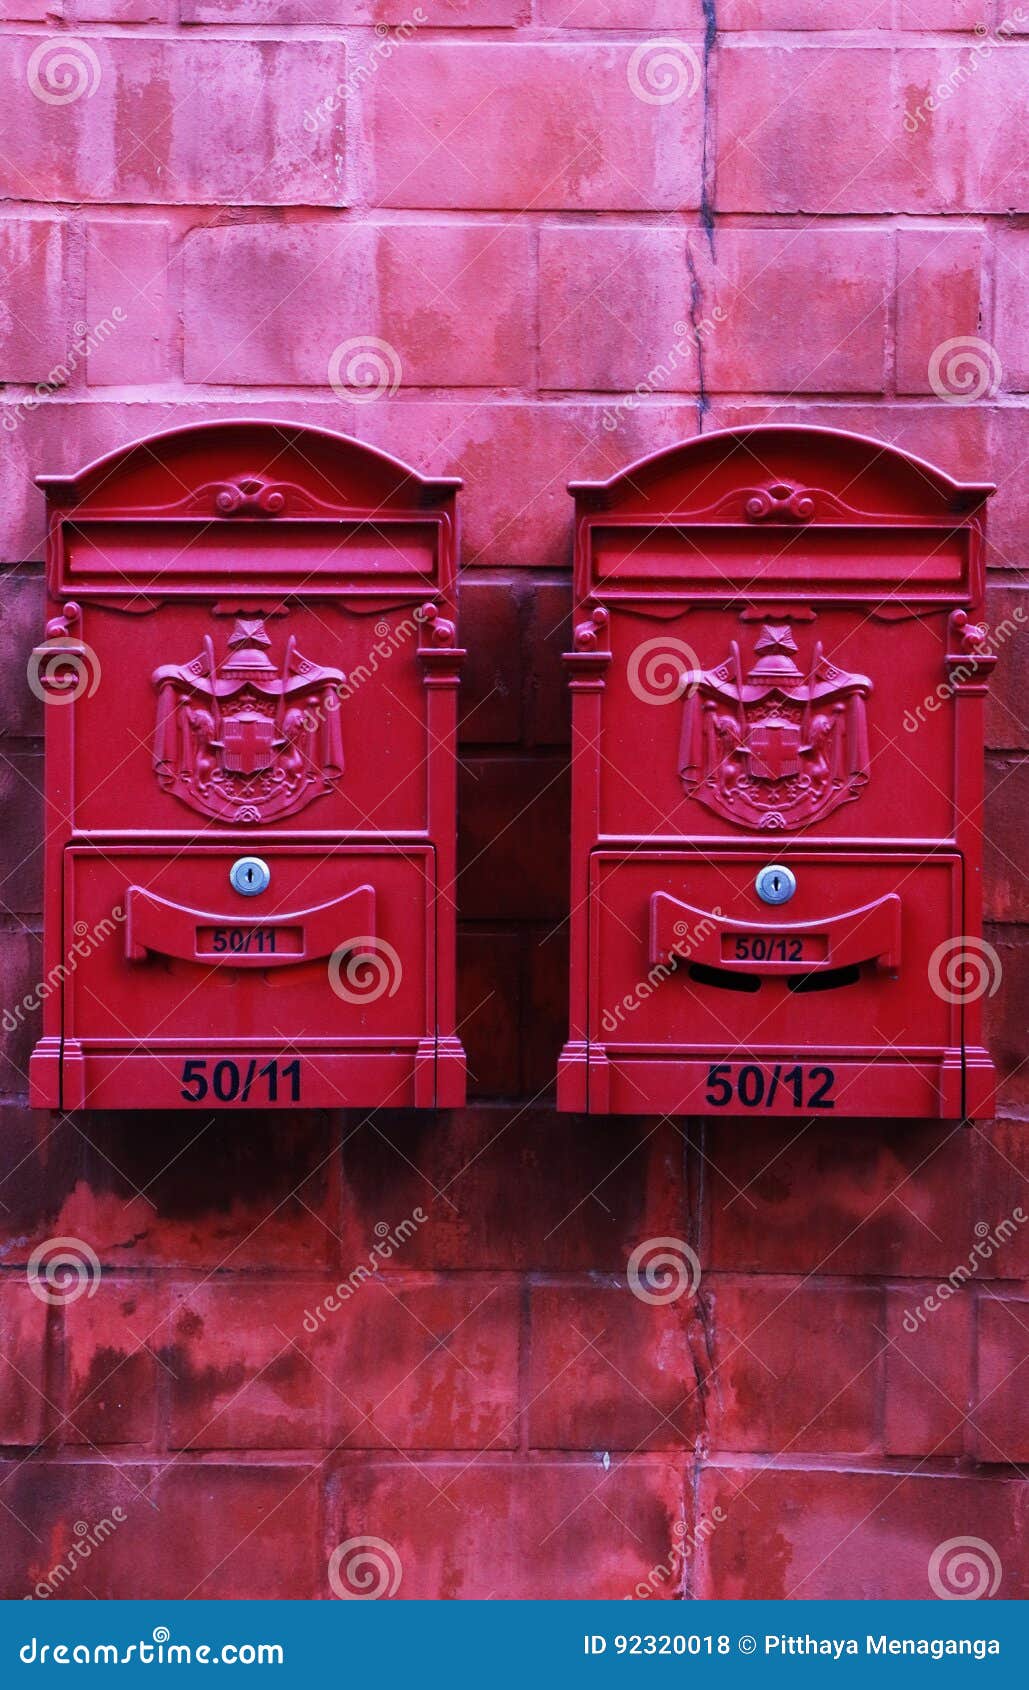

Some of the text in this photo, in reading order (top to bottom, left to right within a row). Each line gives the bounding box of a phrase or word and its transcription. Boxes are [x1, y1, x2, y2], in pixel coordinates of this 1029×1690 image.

[212, 929, 277, 953] 50/11
[735, 937, 803, 962] 50/12
[180, 1059, 302, 1102] 50/11
[705, 1064, 836, 1109] 50/12
